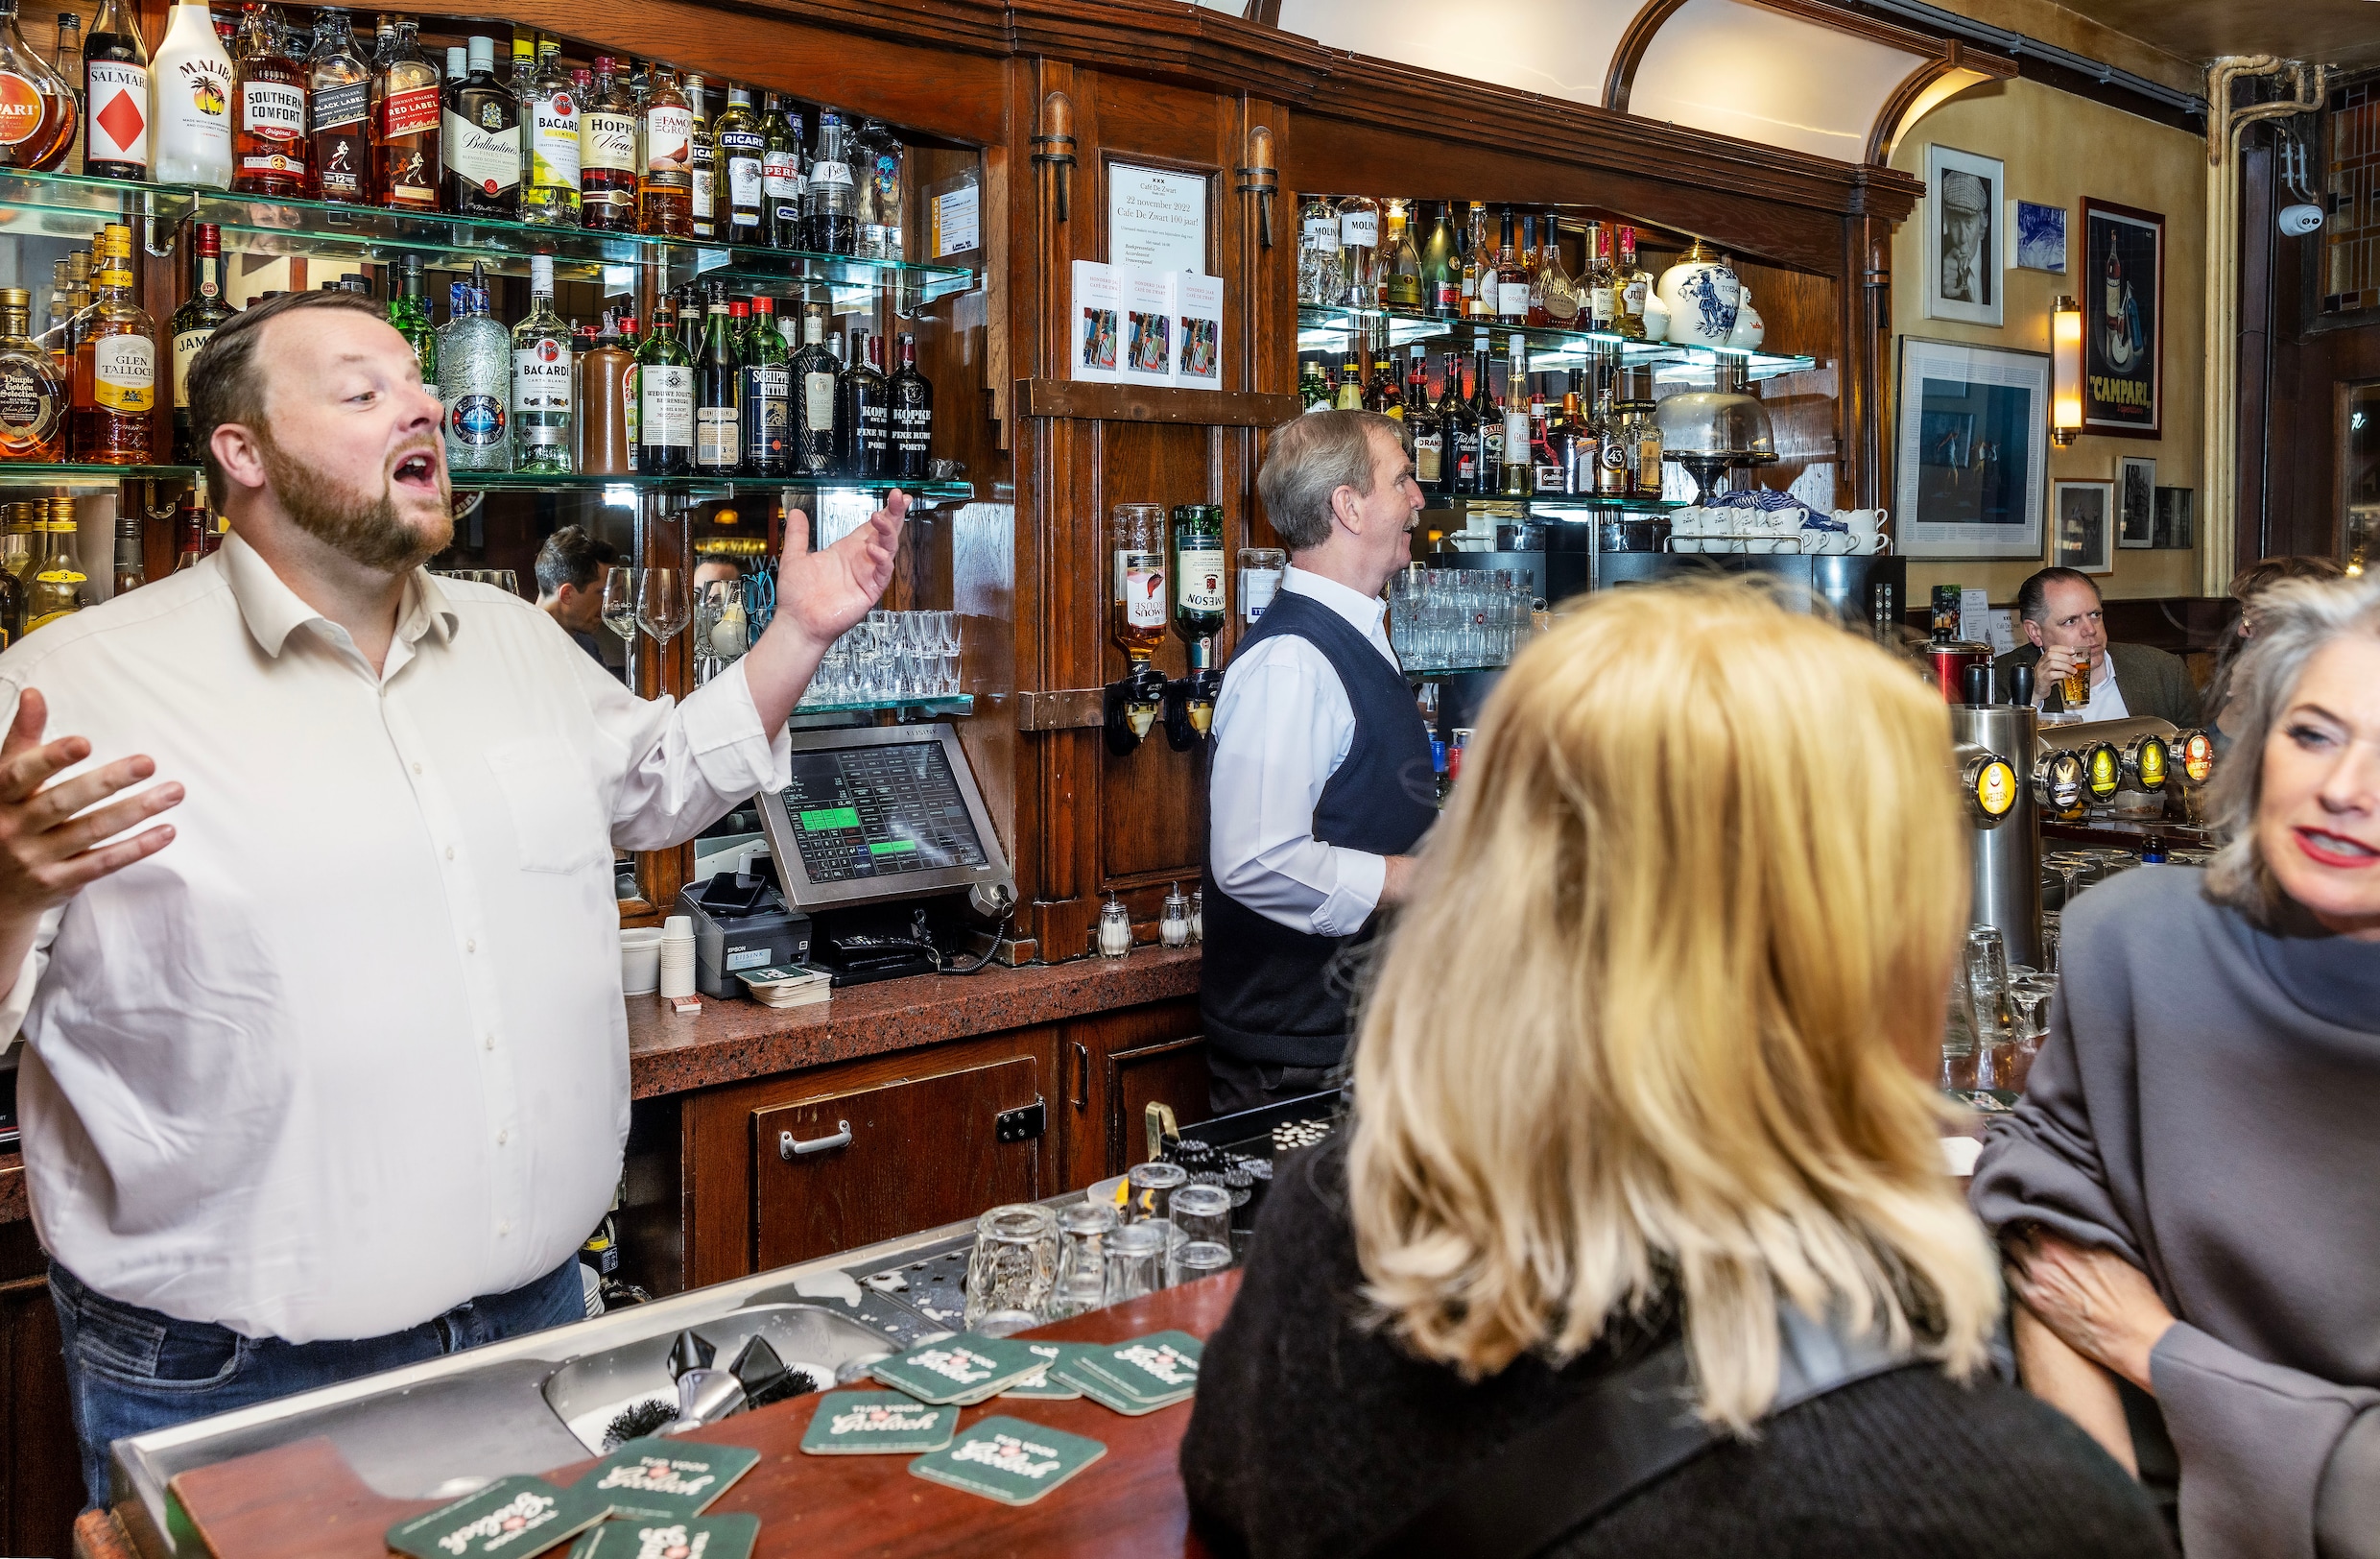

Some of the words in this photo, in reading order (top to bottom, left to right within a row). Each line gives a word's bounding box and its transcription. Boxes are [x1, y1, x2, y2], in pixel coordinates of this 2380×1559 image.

[248, 91, 303, 111] SOUTHERN
[314, 102, 340, 112] BLACK
[389, 107, 408, 116] RED
[410, 100, 439, 111] LABEL
[251, 106, 300, 123] COMFORT
[539, 117, 579, 132] BACARD
[662, 116, 692, 130] FAMO
[265, 128, 292, 136] Original
[662, 125, 692, 135] GROU
[461, 132, 518, 156] Ballantine's
[725, 134, 763, 147] RICARD
[693, 148, 714, 158] ICA
[765, 167, 798, 180] PERN
[823, 163, 847, 181] Bols
[334, 174, 345, 183] 12
[1127, 196, 1135, 204] 22
[1137, 199, 1172, 209] november
[1174, 202, 1191, 212] 2022
[1136, 209, 1147, 219] De
[1149, 211, 1168, 222] Zwart
[1171, 215, 1182, 224] 100
[115, 355, 148, 367] GLEN
[103, 365, 154, 377] TALLOCH
[752, 371, 789, 383] SCHIPPE
[4, 374, 34, 385] Dimple
[0, 389, 38, 398] Selection
[5, 383, 34, 392] Golden
[892, 409, 931, 420] KOPKE
[857, 428, 877, 437] FINE
[1484, 425, 1503, 435] BAIL
[1607, 450, 1623, 463] 43
[1187, 592, 1225, 607] AMESON
[1984, 791, 2008, 803] WEIZEN
